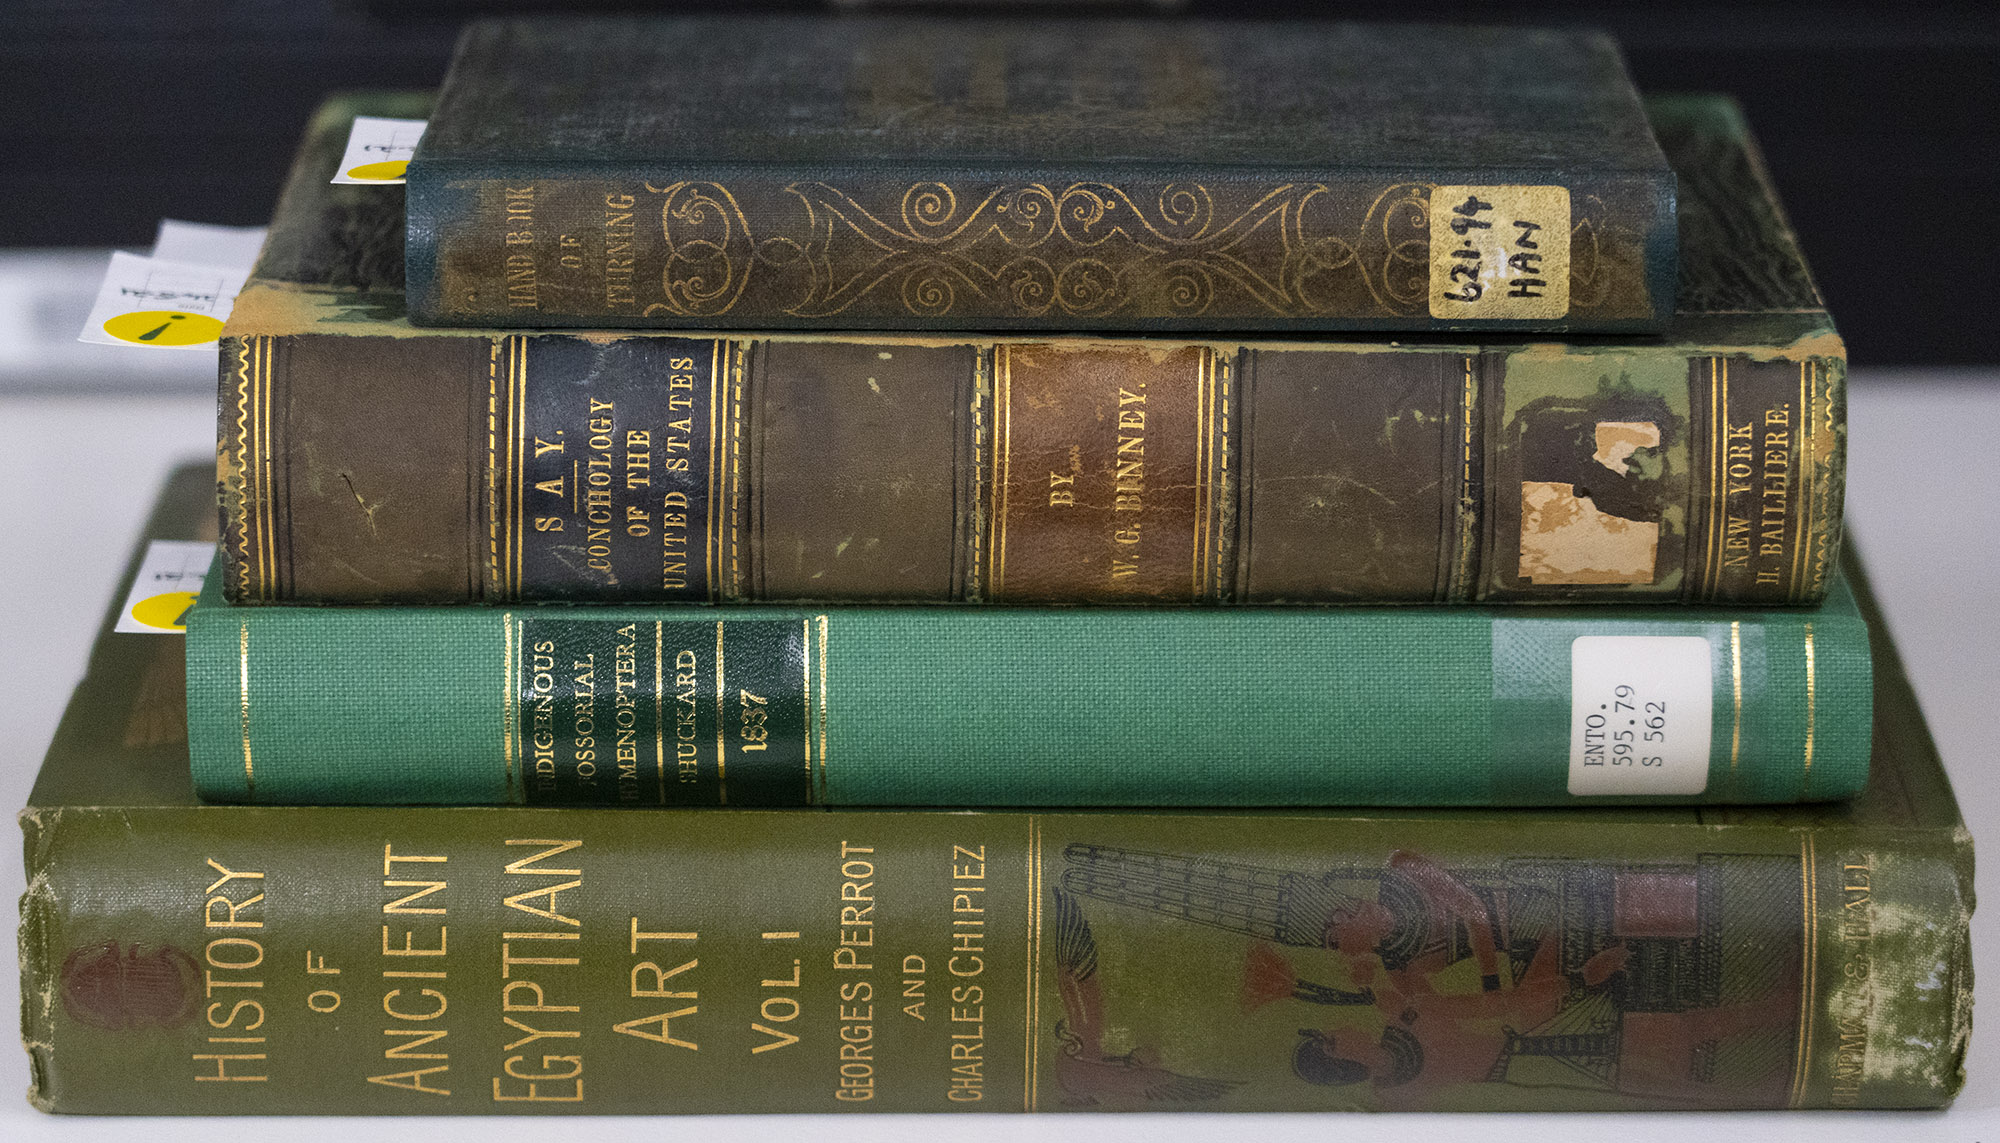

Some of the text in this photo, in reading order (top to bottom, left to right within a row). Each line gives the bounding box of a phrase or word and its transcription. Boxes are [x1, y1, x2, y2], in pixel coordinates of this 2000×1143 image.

[506, 254, 538, 309] HAND
[560, 234, 582, 269] OF
[1507, 220, 1547, 298] HAN
[587, 398, 615, 571] CONCHOLOGY
[626, 430, 651, 537] OF THE
[663, 357, 694, 590] UNITED STATES
[1050, 471, 1074, 507] BY
[1112, 383, 1147, 579] W. G. BINNEY.
[1724, 422, 1754, 568] NEW YORK
[1755, 403, 1790, 585] H. BAILLIERE.
[740, 688, 769, 754] 1837
[1583, 704, 1607, 768] ENTO.
[1612, 684, 1636, 767] 595.79
[1641, 701, 1666, 767] S 562
[193, 857, 268, 1082] HISTORY
[306, 950, 342, 1013] OF
[367, 843, 451, 1096] ANCIENT
[493, 838, 584, 1102] EGYPTIAN
[613, 917, 699, 1051] ART
[751, 931, 801, 1054] VOL. I
[833, 840, 875, 1102] GEORGES PERROT
[903, 954, 926, 1022] AND
[947, 845, 985, 1102] CHARLES CHIPIEZ
[1844, 953, 1870, 981] &
[1831, 988, 1869, 1105] HAPMA
